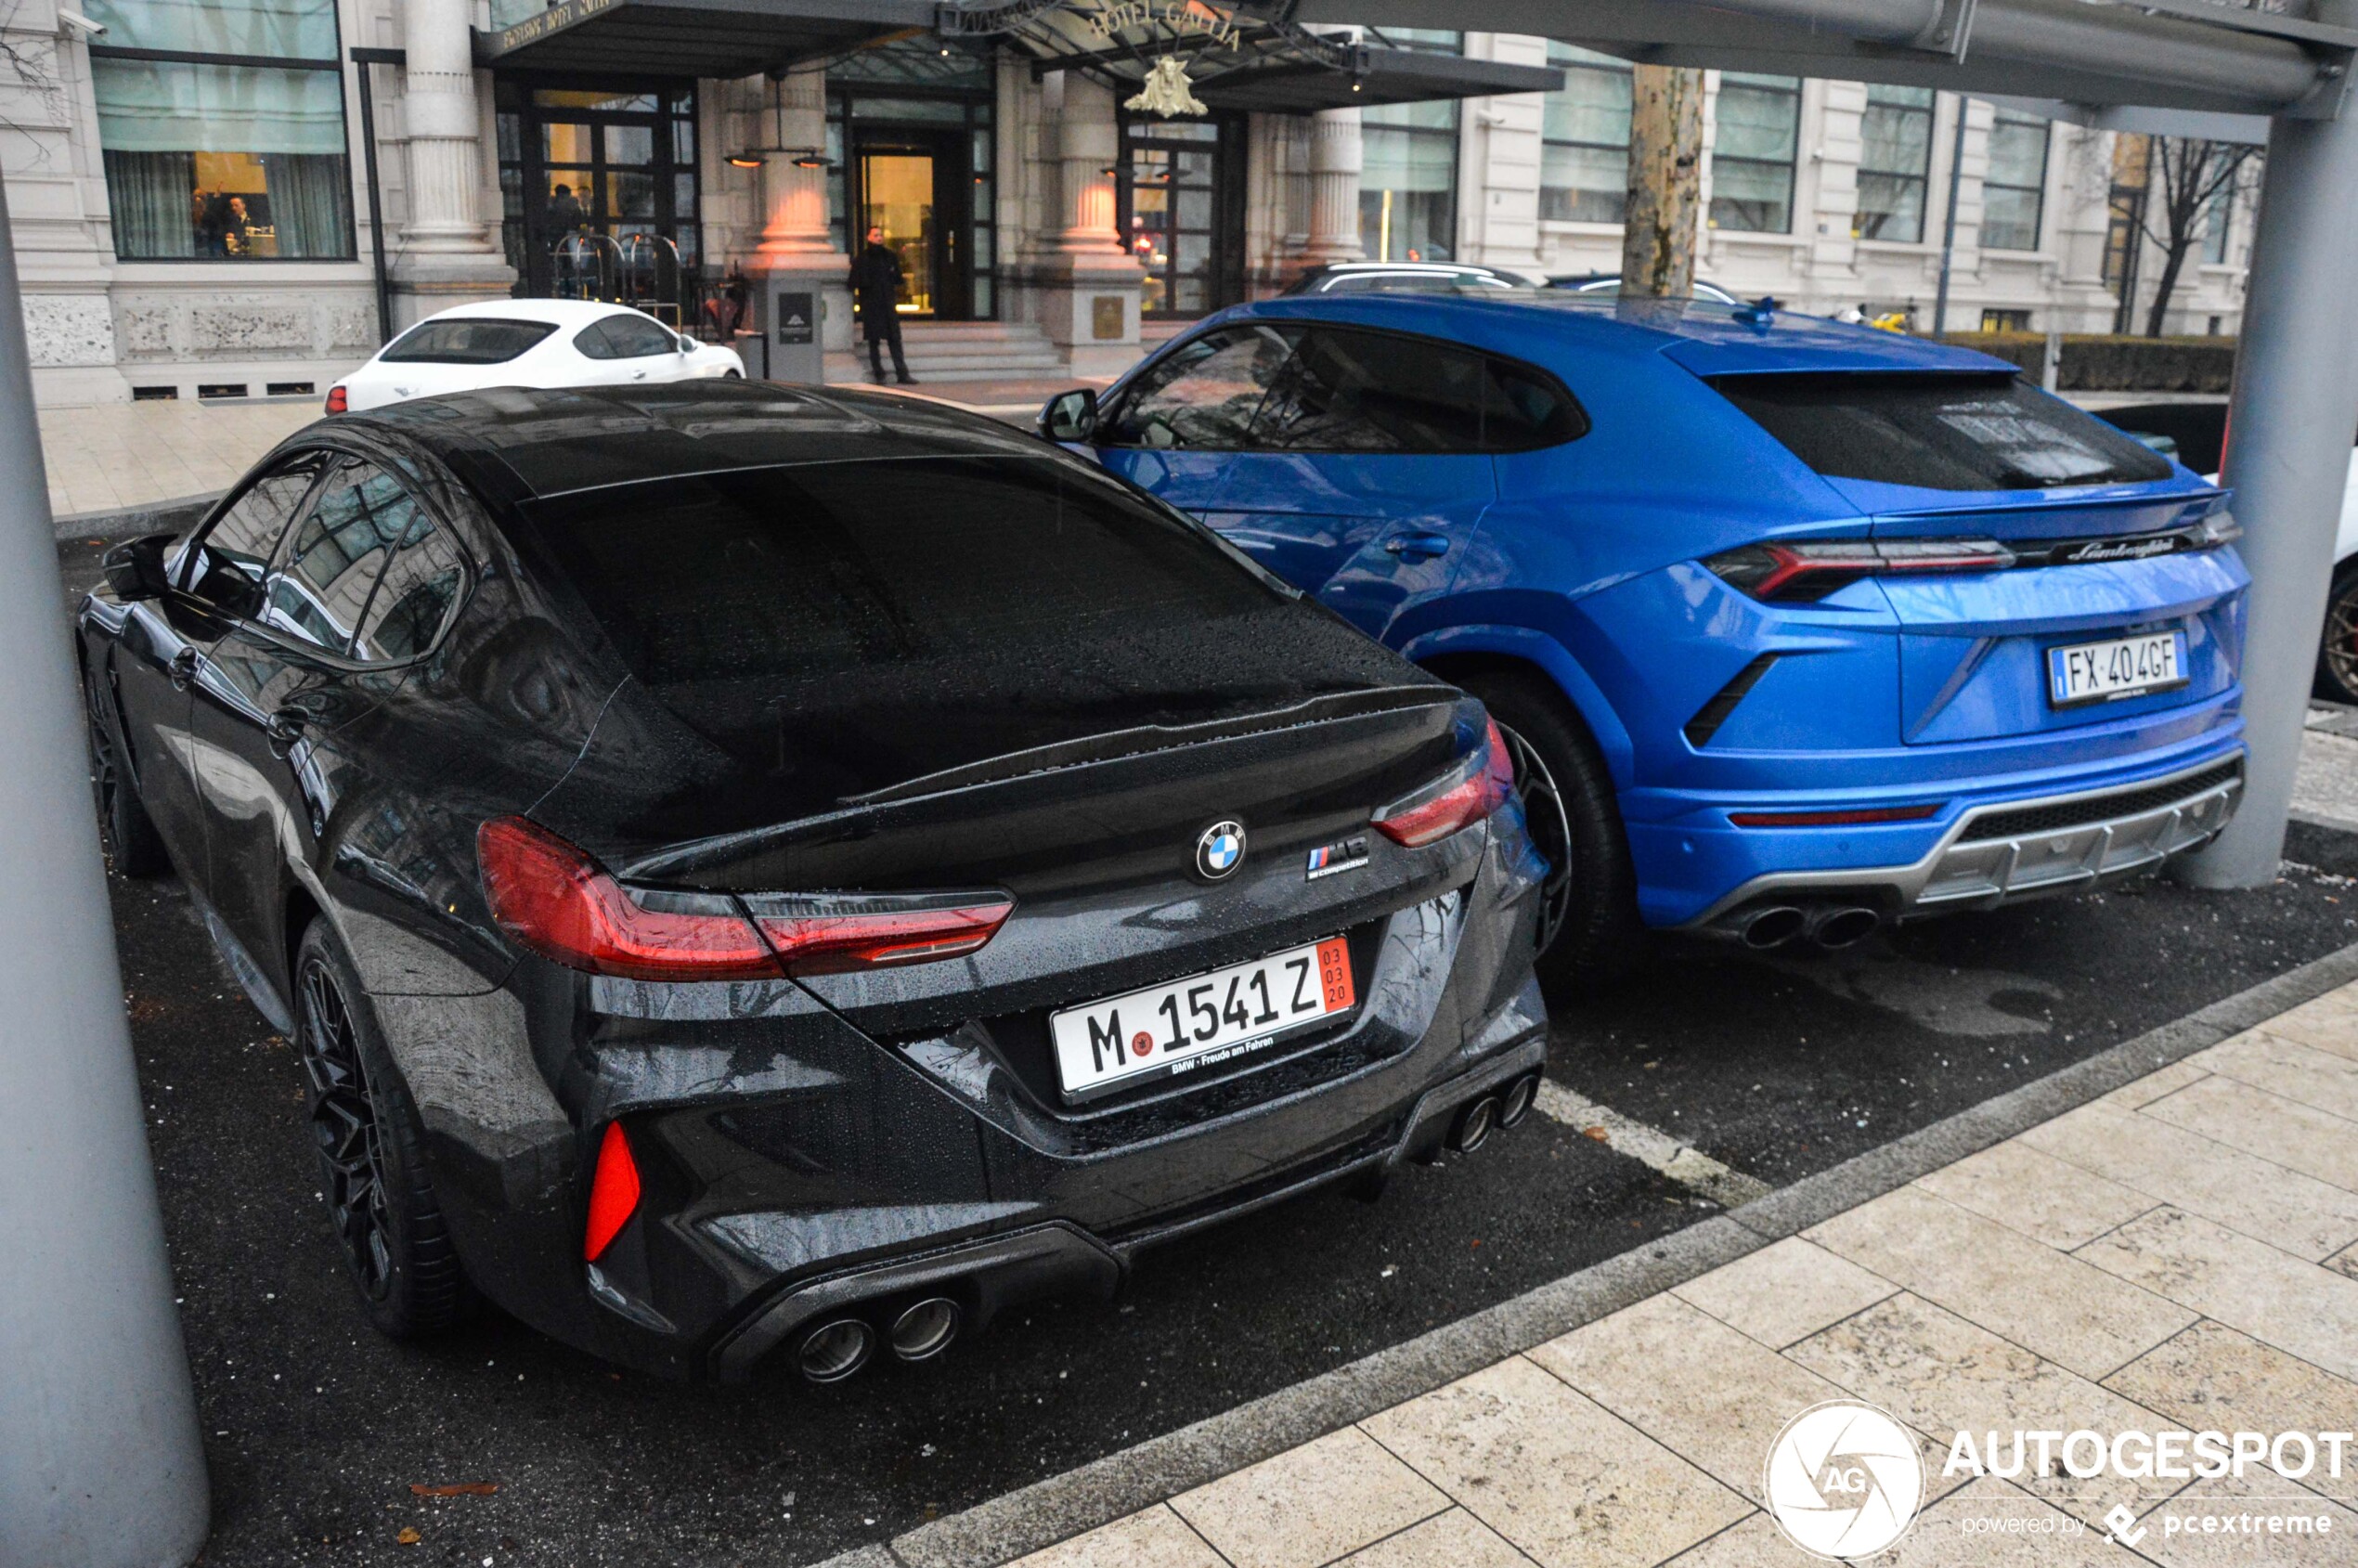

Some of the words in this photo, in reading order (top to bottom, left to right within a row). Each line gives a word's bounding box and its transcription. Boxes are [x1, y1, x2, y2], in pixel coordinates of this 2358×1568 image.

[1090, 0, 1160, 40] HOTEL
[1166, 2, 1240, 53] GALLIA
[2067, 538, 2175, 561] Lamborghini
[2069, 650, 2098, 692] FX
[2108, 639, 2172, 685] 404GF
[1205, 823, 1244, 847] BMW
[1318, 858, 1369, 878] competition
[1323, 948, 1341, 965] 03
[1326, 966, 1342, 984] 03
[1328, 985, 1345, 1004] 20
[1087, 1008, 1126, 1072] M
[1159, 968, 1279, 1053] 1541
[1285, 956, 1316, 1015] Z
[1172, 1058, 1195, 1074] BMW
[1201, 1049, 1231, 1067] Freude
[1231, 1045, 1245, 1057] am
[1245, 1036, 1274, 1052] Fahren
